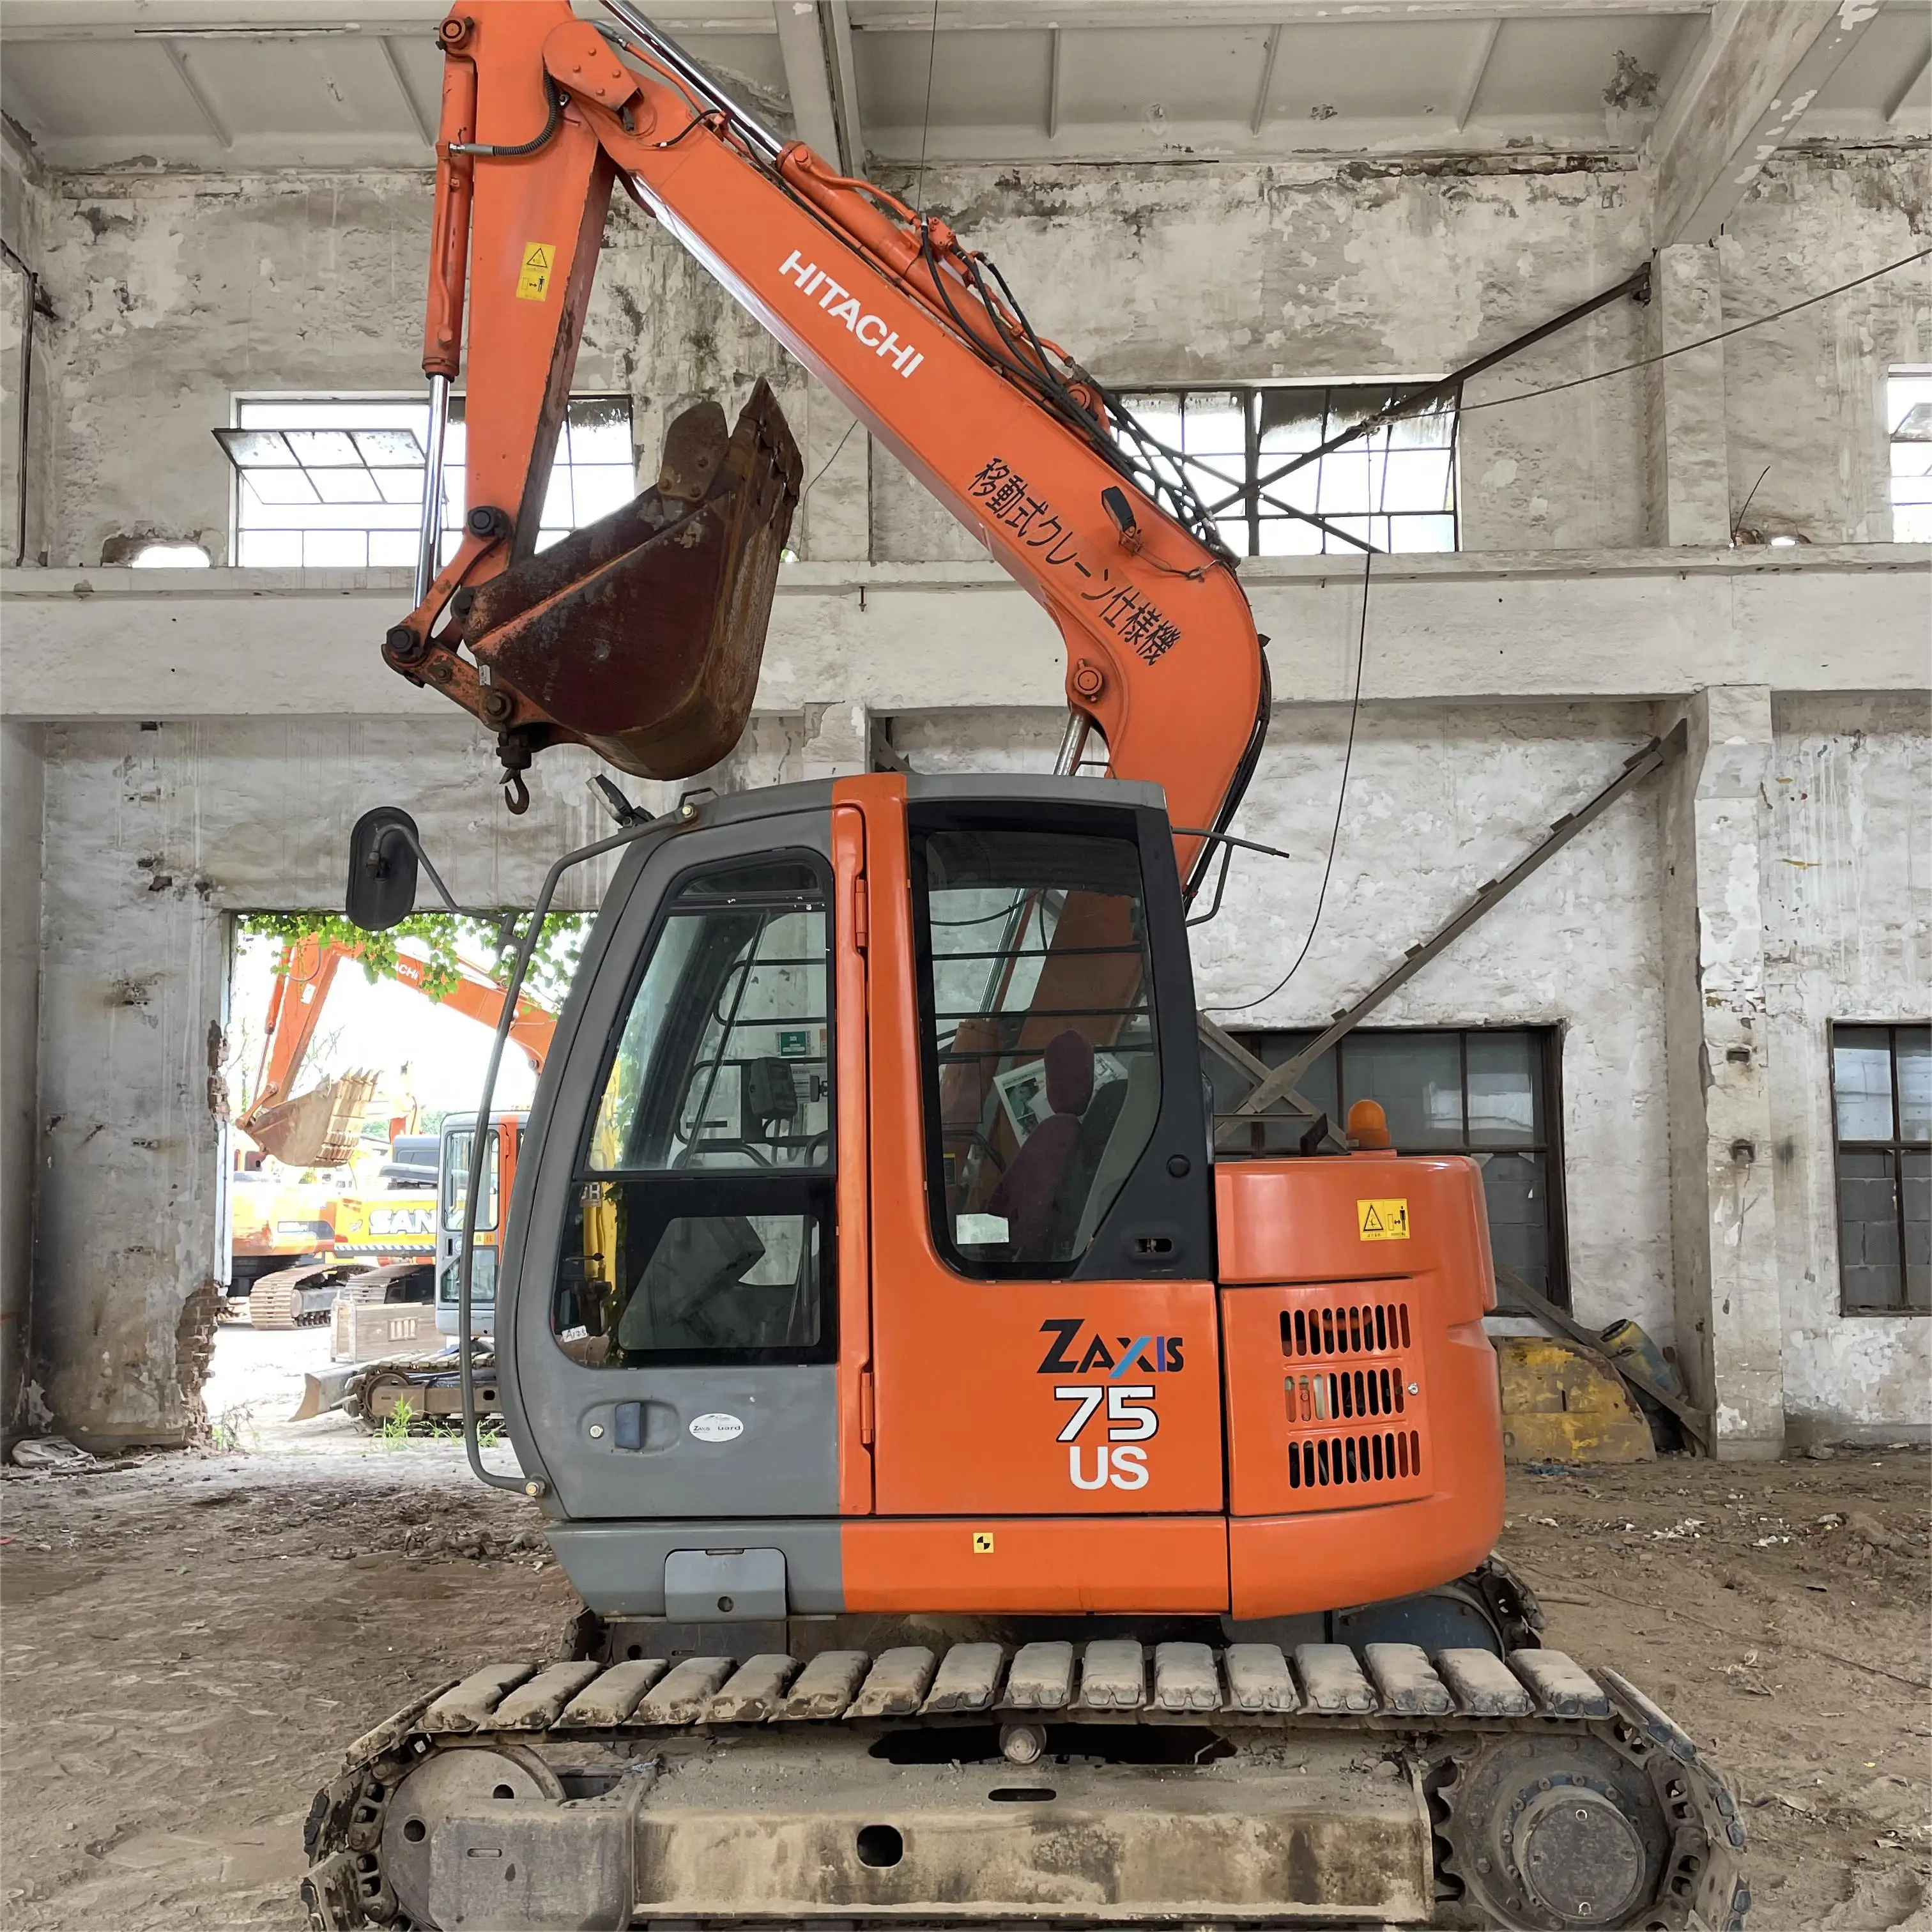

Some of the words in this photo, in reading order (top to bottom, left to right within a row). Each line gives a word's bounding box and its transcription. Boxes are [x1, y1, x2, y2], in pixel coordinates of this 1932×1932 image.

[778, 250, 924, 378] HITACHI
[968, 458, 1181, 666] 移動式クレーン仕様機
[1036, 1318, 1184, 1379] ZAXIS
[1054, 1384, 1160, 1443] 75
[1069, 1445, 1149, 1491] US
